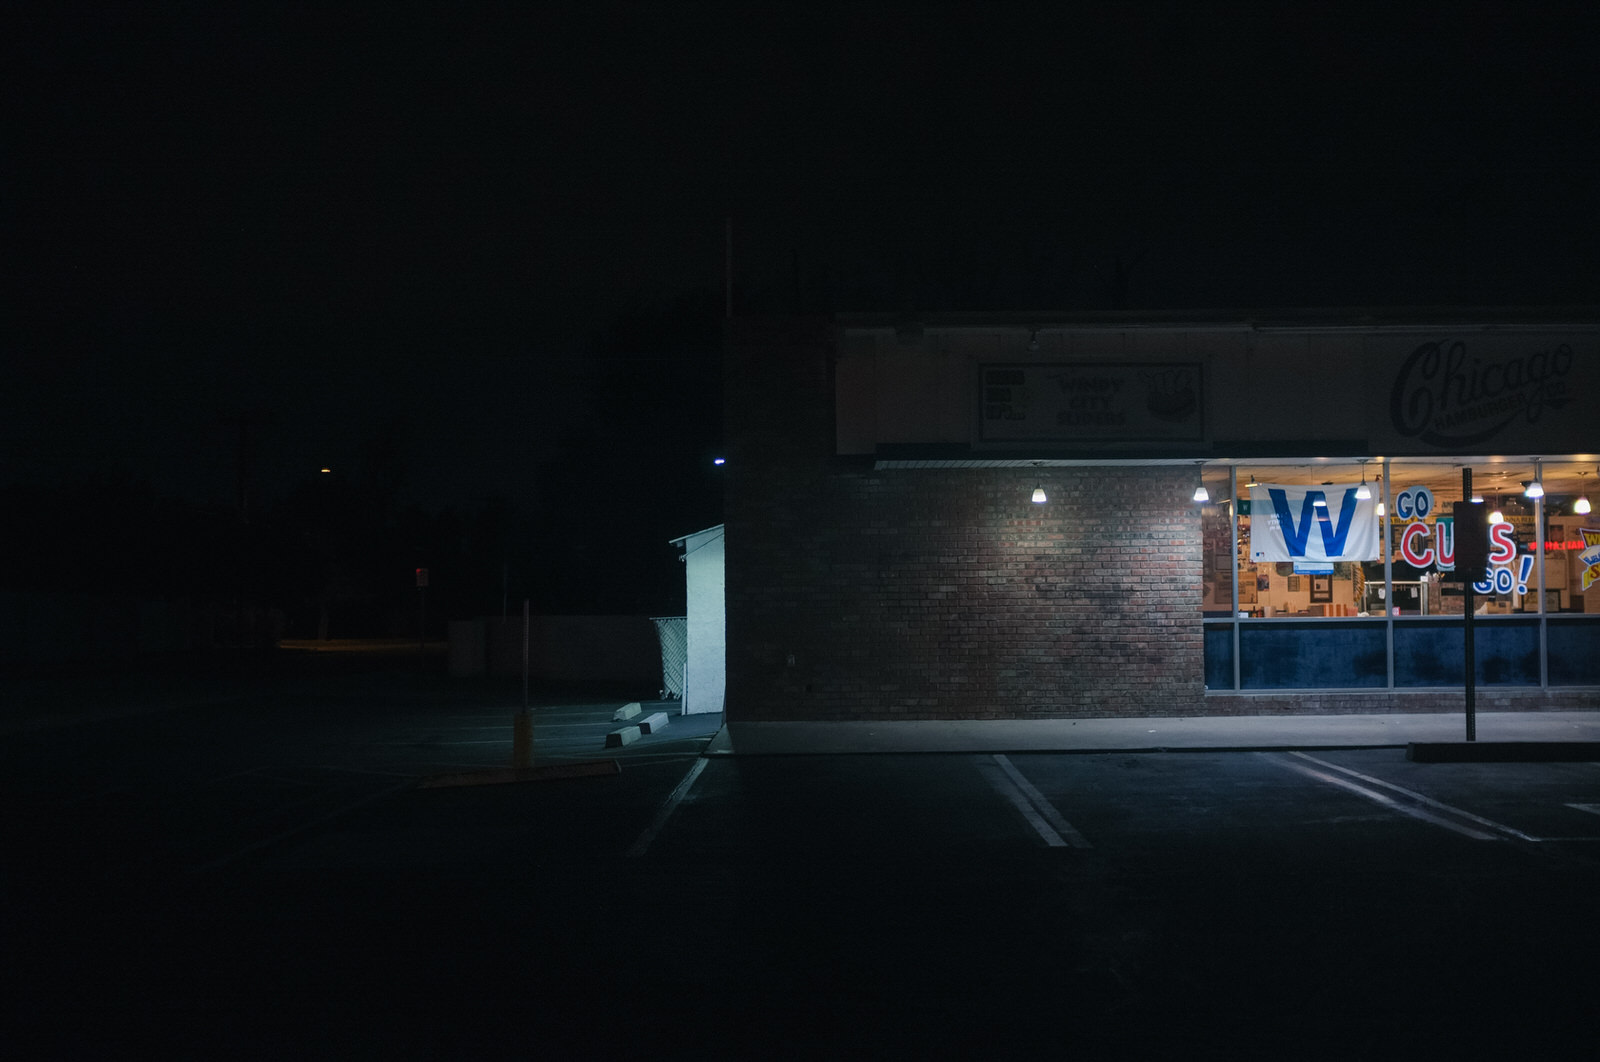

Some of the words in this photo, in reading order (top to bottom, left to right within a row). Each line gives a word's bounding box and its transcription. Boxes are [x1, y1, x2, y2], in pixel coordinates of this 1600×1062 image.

[1069, 394, 1114, 409] CITY
[1390, 339, 1573, 436] Chicago
[1434, 392, 1527, 430] HAMBURGER
[1268, 488, 1359, 556] W
[1396, 489, 1430, 521] GO
[1400, 522, 1516, 568] CUS
